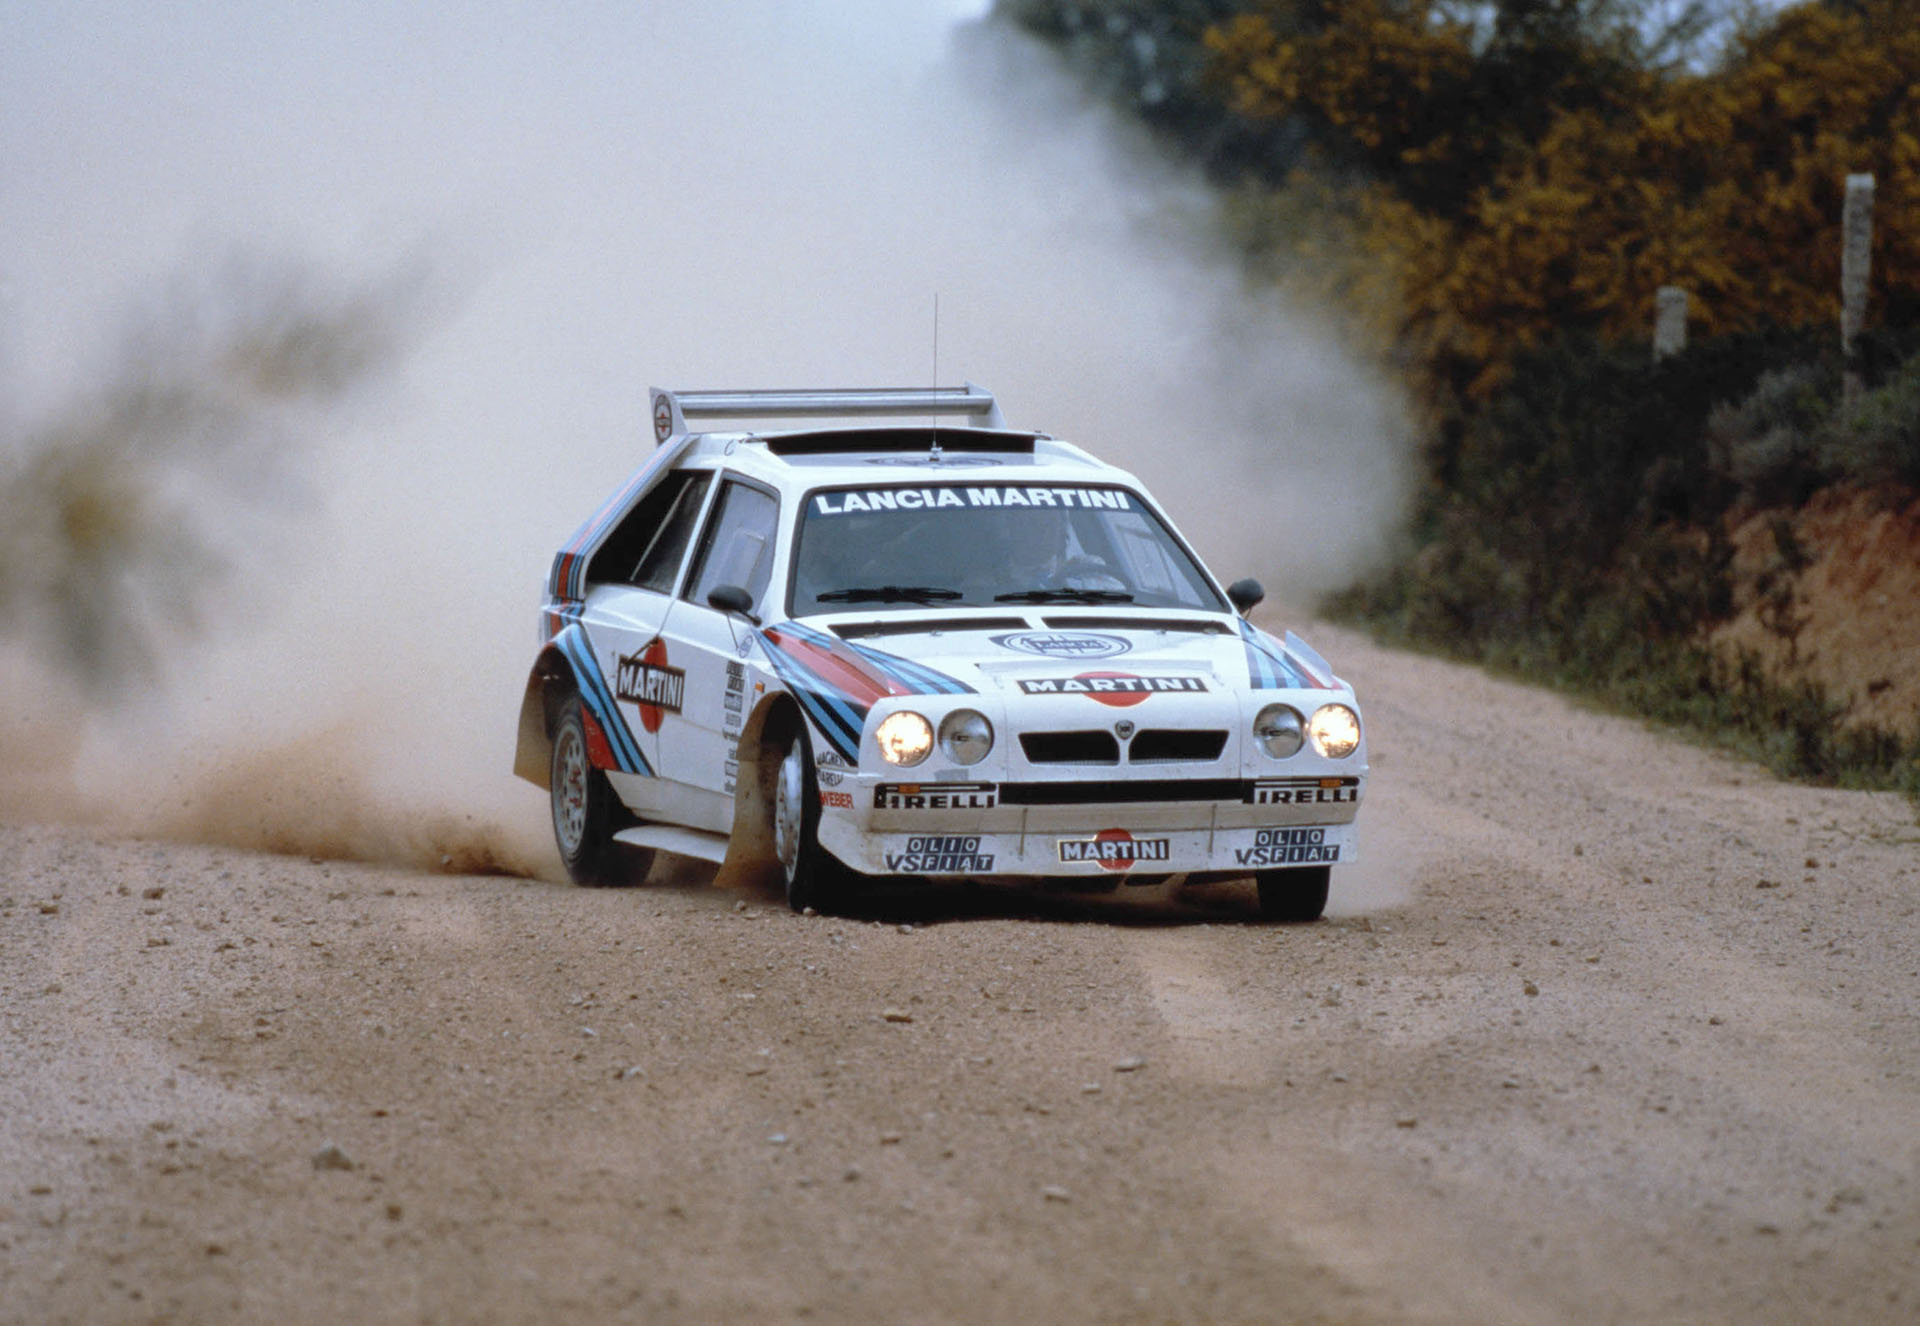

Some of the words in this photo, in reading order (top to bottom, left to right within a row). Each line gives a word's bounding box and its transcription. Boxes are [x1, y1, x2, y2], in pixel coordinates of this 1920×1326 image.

[814, 487, 965, 514] LANCIA
[965, 486, 1131, 509] MARTINI
[620, 664, 684, 708] MARTINI
[1024, 678, 1200, 693] MARTINI
[819, 791, 855, 809] WEBER
[907, 838, 980, 853] OLIO
[1256, 829, 1325, 846] OLIO
[1062, 840, 1166, 860] MARTINI
